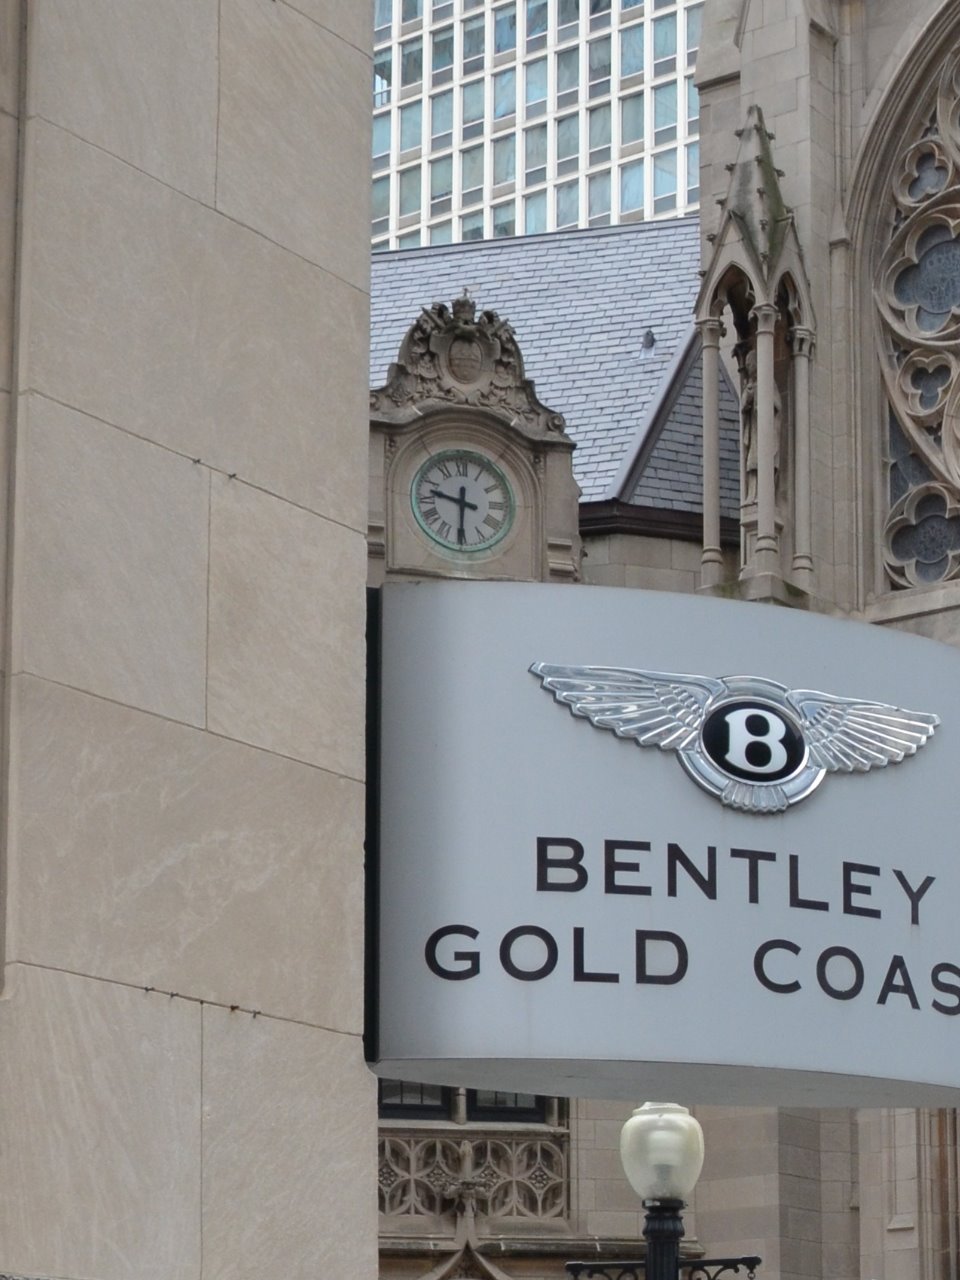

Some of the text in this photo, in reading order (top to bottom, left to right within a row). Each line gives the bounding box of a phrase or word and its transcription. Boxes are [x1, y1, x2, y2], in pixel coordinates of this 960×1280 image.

[725, 708, 788, 774] B
[536, 836, 936, 925] BENTLEY
[425, 924, 688, 985] GOLD
